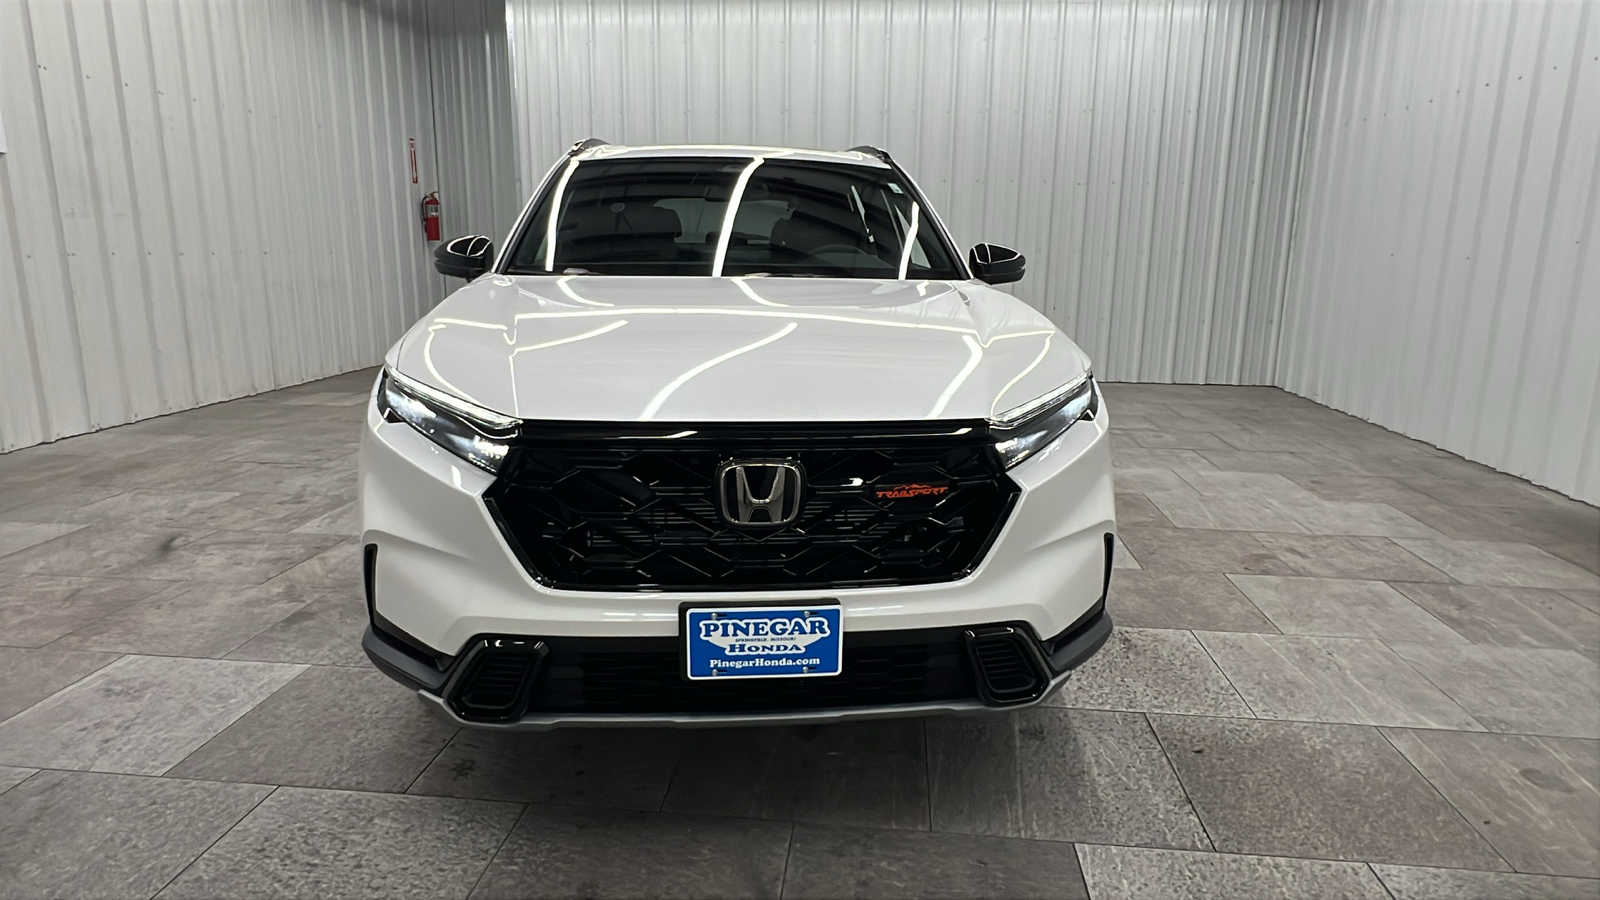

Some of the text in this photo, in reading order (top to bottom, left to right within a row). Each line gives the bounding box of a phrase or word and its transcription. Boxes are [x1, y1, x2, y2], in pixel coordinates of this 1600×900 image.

[876, 486, 948, 498] TRAILSPORT
[702, 620, 828, 638] PINEGAR
[709, 657, 820, 669] PinegarHonda.com
